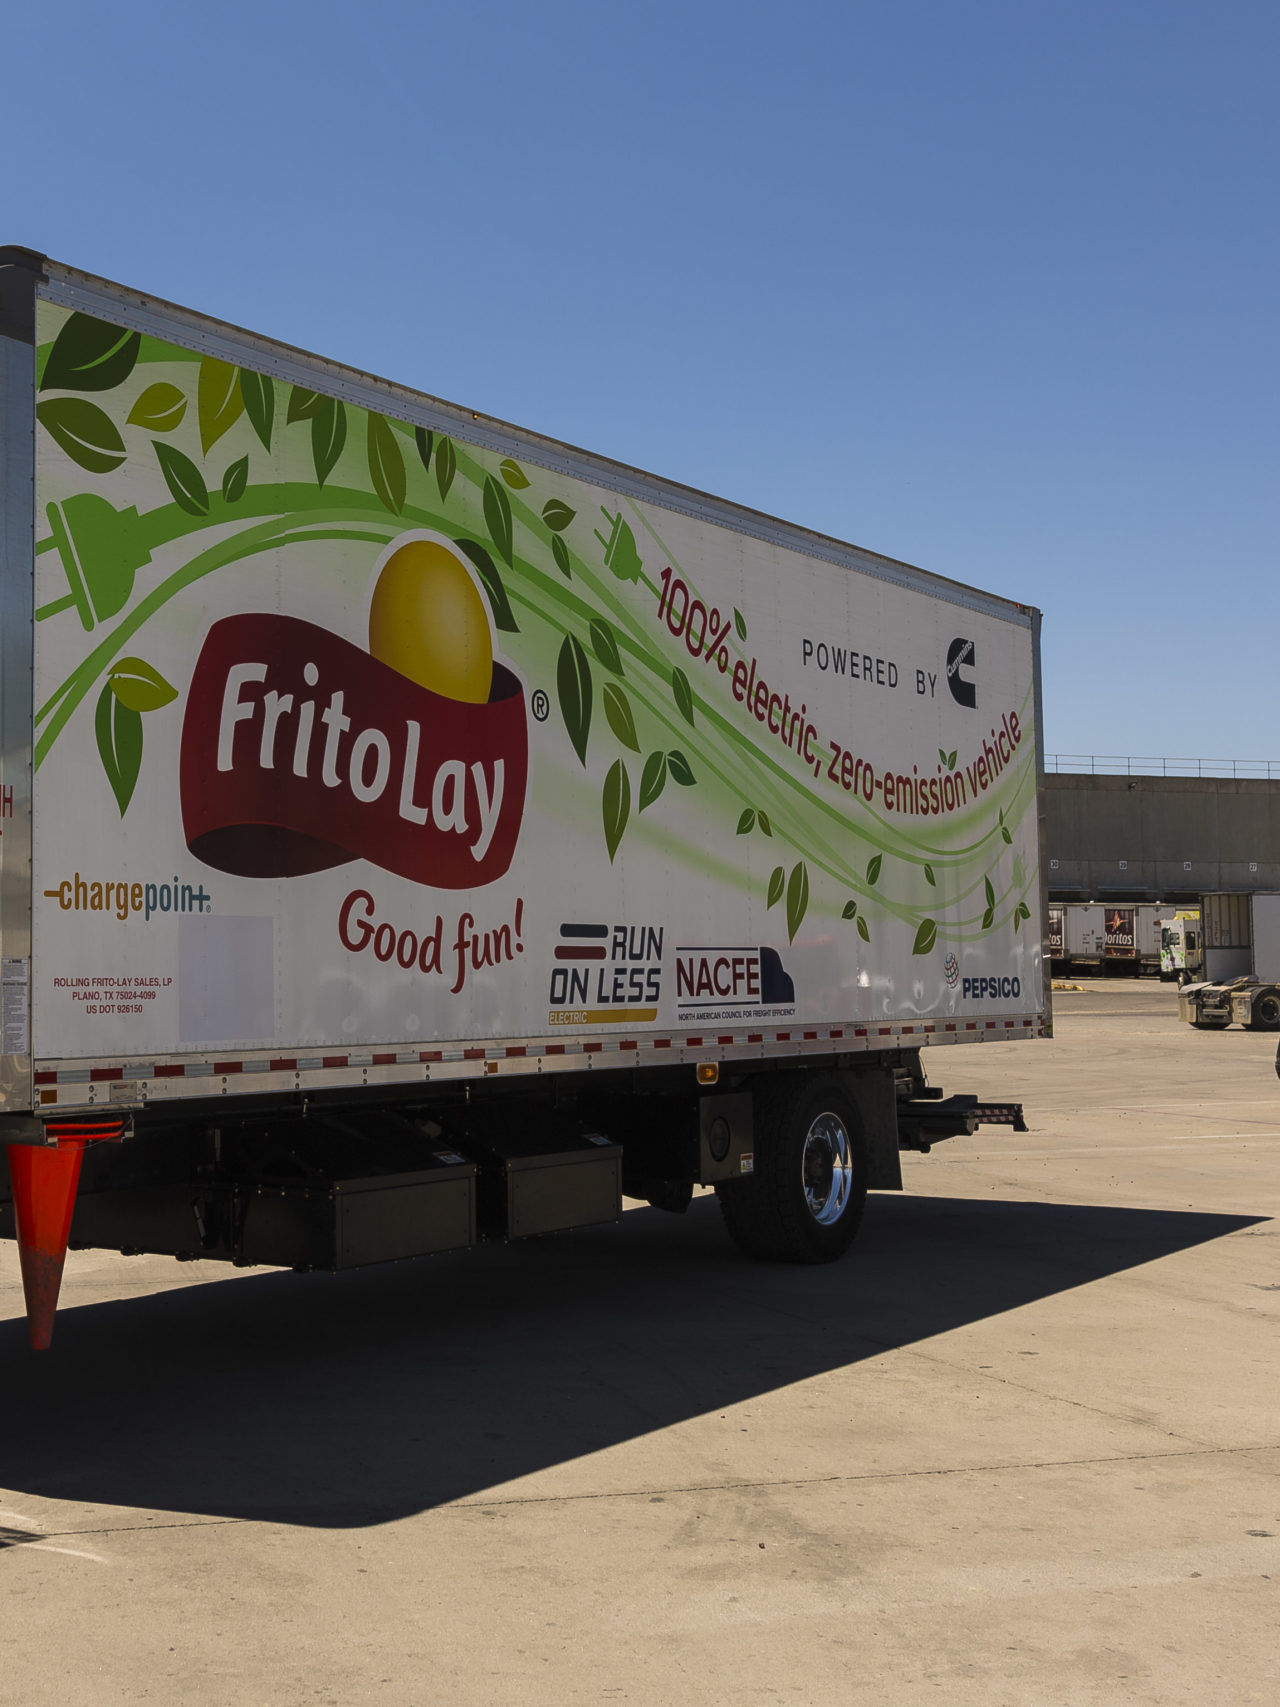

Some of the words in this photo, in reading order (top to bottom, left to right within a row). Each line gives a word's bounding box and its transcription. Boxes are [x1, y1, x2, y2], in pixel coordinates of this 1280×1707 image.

[802, 638, 898, 689] POWERED
[916, 669, 937, 698] BY
[946, 640, 974, 677] Cummins
[657, 566, 732, 674] 100%
[732, 657, 822, 778] electric,
[827, 741, 968, 816] zero-emission
[966, 711, 1022, 798] vehicle
[338, 889, 443, 975] Good
[450, 897, 524, 994] fun!
[611, 925, 664, 961] RUN
[53, 977, 90, 987] ROLLING
[91, 977, 132, 987] FRITO-LAY
[134, 977, 161, 988] SALES,
[163, 977, 173, 987] LP
[549, 967, 590, 1005] ON
[596, 967, 662, 1004] LESS
[676, 957, 761, 997] NACFE
[962, 976, 1021, 999] PEPSICO
[72, 991, 102, 1002] PLANO,
[104, 991, 114, 1000] TX
[115, 991, 157, 1001] 75024-4099
[86, 1004, 98, 1014] US
[99, 1004, 115, 1014] DOT
[116, 1004, 143, 1013] 926150
[678, 1012, 695, 1021] NORTH
[696, 1011, 721, 1020] AMERICAN
[722, 1010, 742, 1019] COUNCIL
[743, 1009, 752, 1018] FOR
[753, 1009, 771, 1017] FREIGHT
[772, 1008, 796, 1017] EFFICIENCY
[549, 1011, 588, 1024] ELECTRIC
